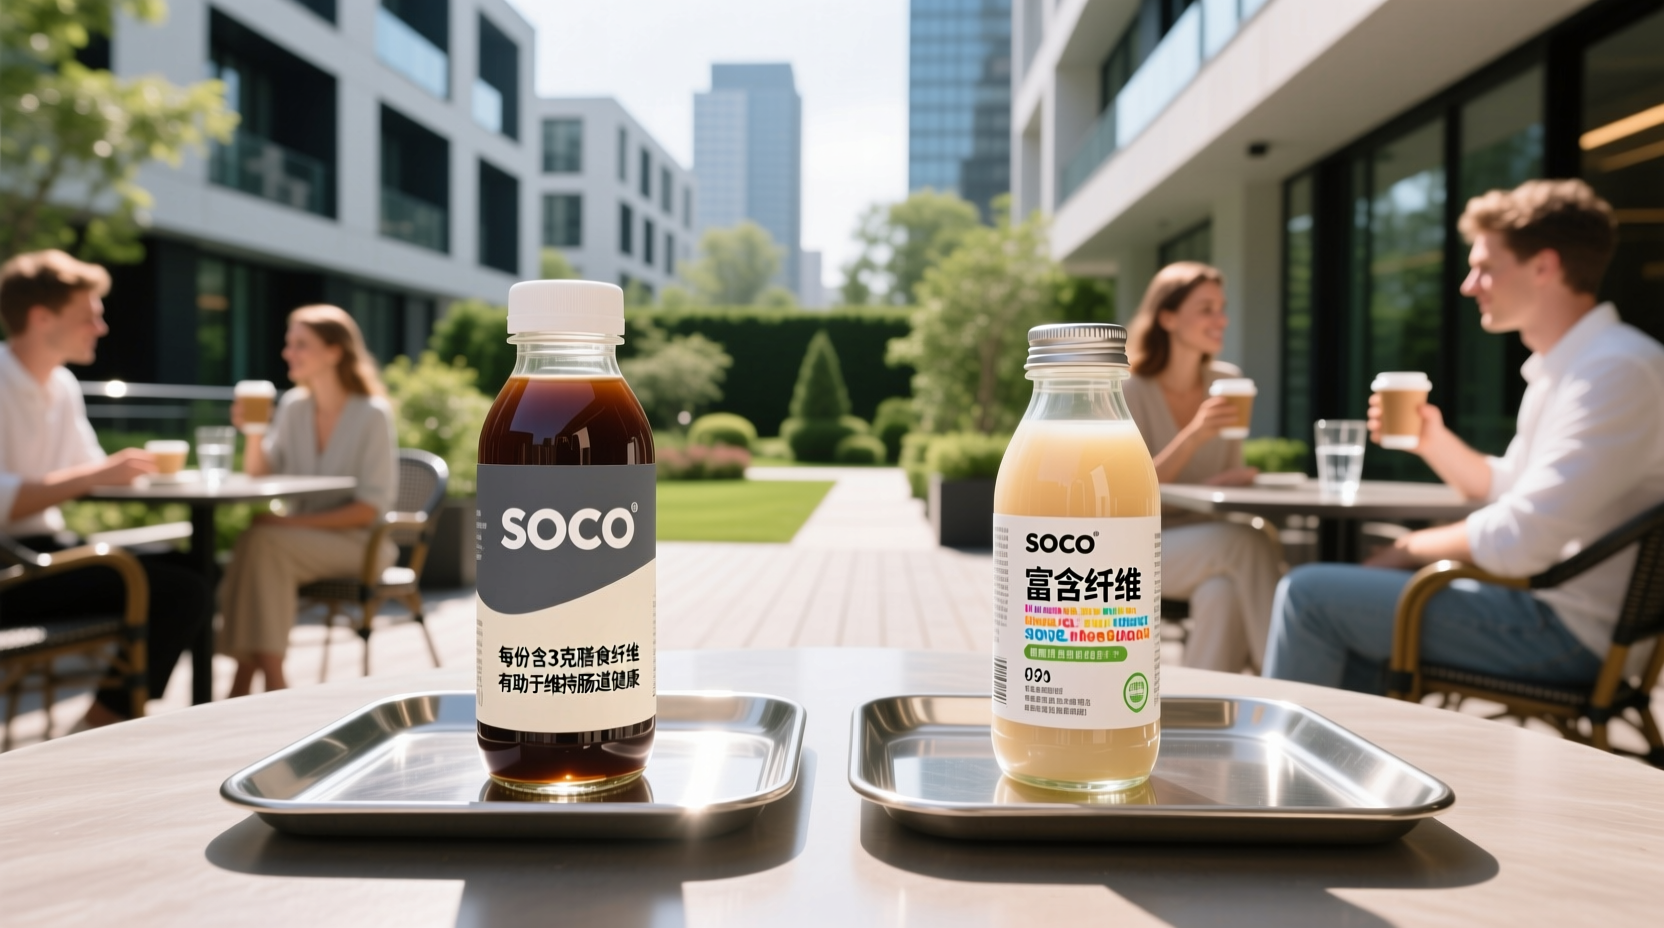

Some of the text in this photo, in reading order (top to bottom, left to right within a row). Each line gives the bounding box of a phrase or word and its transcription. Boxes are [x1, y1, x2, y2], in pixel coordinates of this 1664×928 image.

[501, 507, 635, 550] SOCO
[1026, 533, 1095, 554] SOCO
[1025, 566, 1141, 603] 富含纤维
[499, 642, 640, 668] 每份含3克膳食纤维
[498, 668, 640, 695] 有助于维持肠道健康
